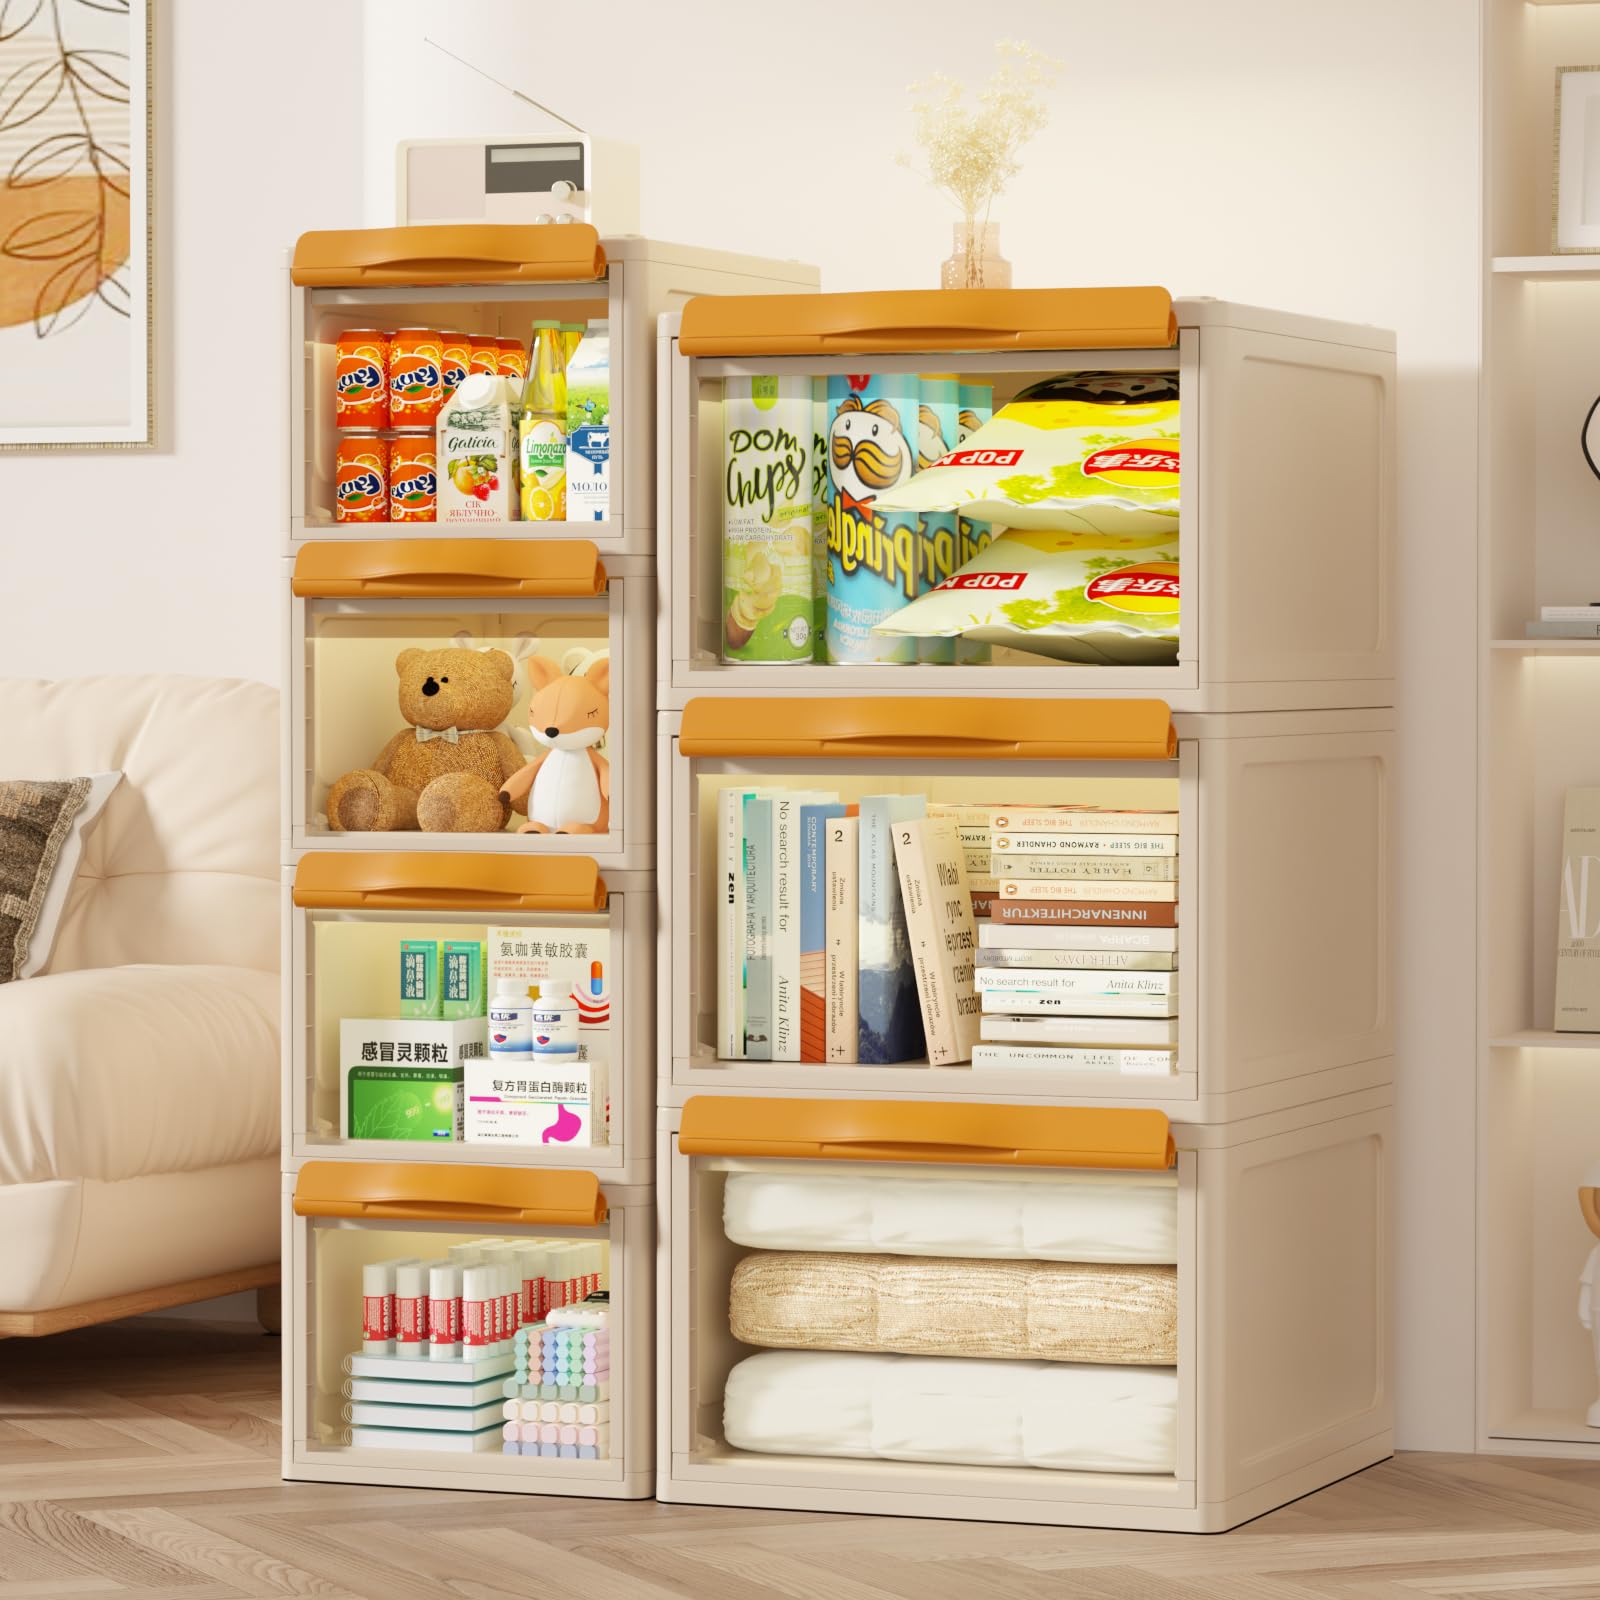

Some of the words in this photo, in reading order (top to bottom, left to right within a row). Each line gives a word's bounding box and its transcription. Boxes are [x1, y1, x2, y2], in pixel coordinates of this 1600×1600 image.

[448, 437, 496, 452] Galicia
[962, 451, 1017, 465] POP
[964, 574, 1019, 588] POP
[778, 801, 790, 820] No
[834, 830, 843, 842] 2
[902, 832, 912, 845] 2
[778, 824, 789, 869] search
[1016, 839, 1056, 848] CHANDLER
[1059, 840, 1099, 849] RAYMOND
[1110, 841, 1131, 850] SLEEP
[1133, 841, 1147, 850] BIG
[1149, 841, 1165, 850] THE
[1028, 866, 1077, 875] POTTER
[1081, 867, 1131, 876] HARRY
[779, 873, 789, 909] result
[914, 880, 923, 907] Zmiana
[1002, 907, 1147, 921] INNENARCHITEKTUR
[779, 914, 789, 933] for
[500, 941, 588, 959] 氨咖黄敏胶囊
[979, 976, 996, 986] No
[998, 977, 1027, 986] search
[1029, 978, 1059, 987] result
[1061, 978, 1076, 987] for
[1106, 979, 1135, 989] Anita
[1136, 980, 1163, 990] Klinz
[778, 975, 790, 1013] Anita
[778, 1016, 790, 1053] Klinz
[361, 1041, 449, 1063] 感冒灵颗粒
[492, 1079, 588, 1094] 复方胃蛋白酶颗粒
